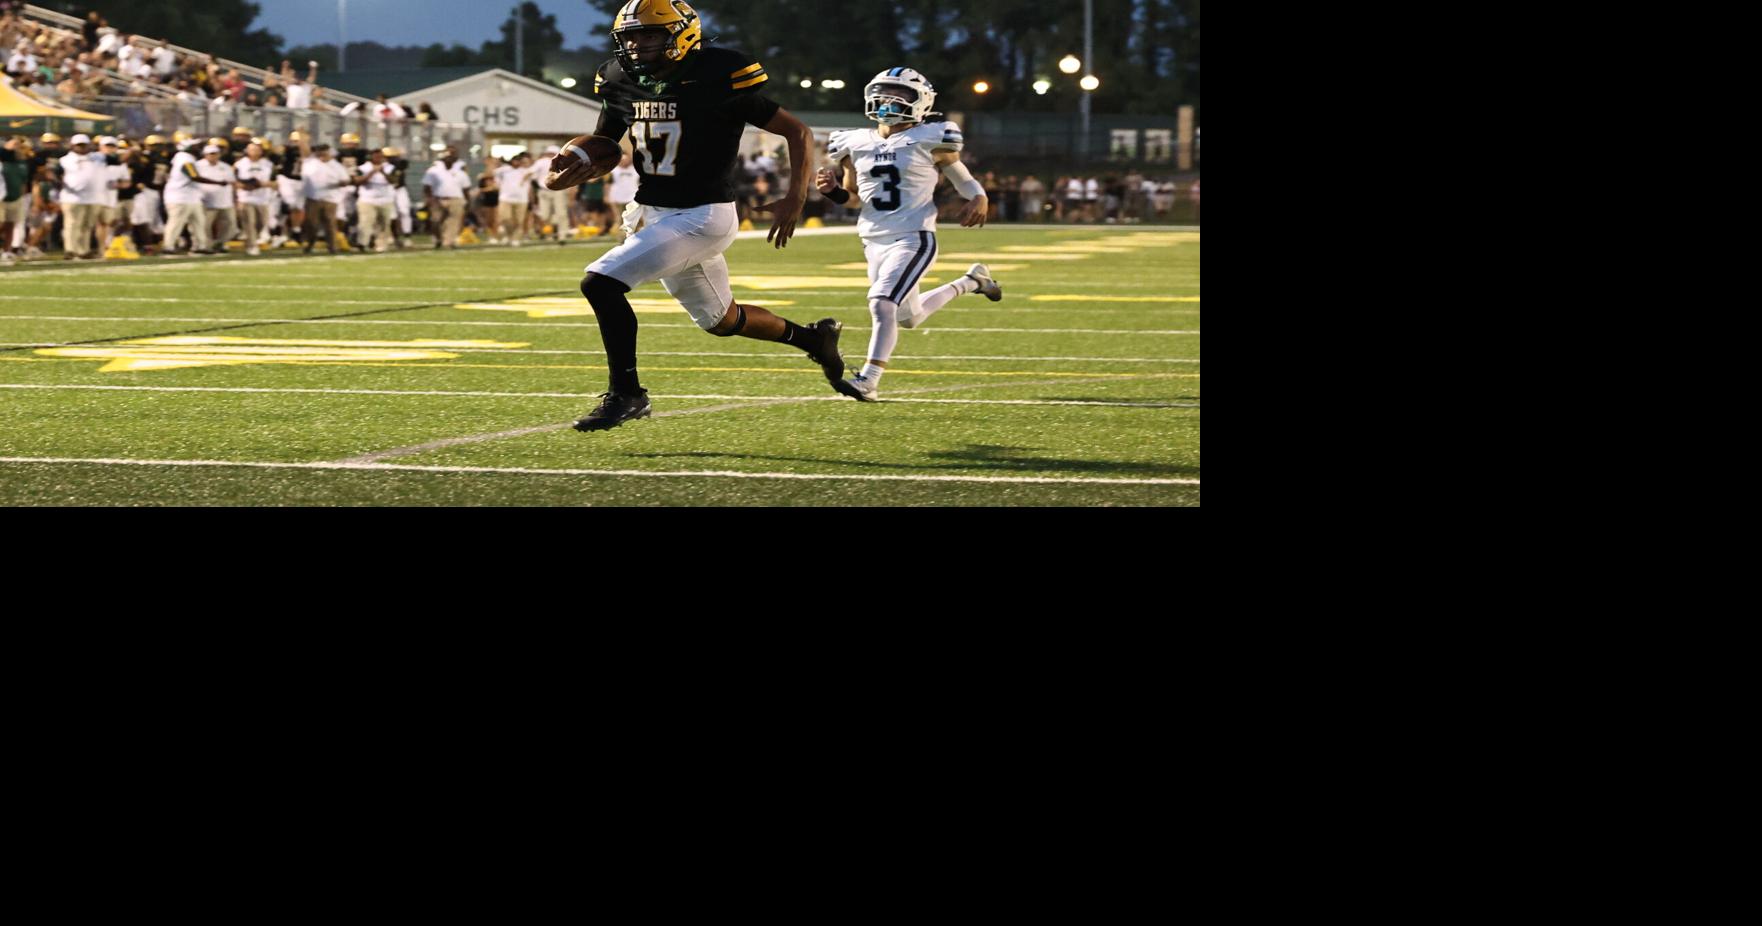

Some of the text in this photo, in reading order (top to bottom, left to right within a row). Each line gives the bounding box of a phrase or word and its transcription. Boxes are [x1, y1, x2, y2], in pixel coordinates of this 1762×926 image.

[463, 105, 519, 126] CHS
[632, 102, 677, 119] TIGERS
[630, 120, 683, 176] 17
[870, 164, 901, 211] 3
